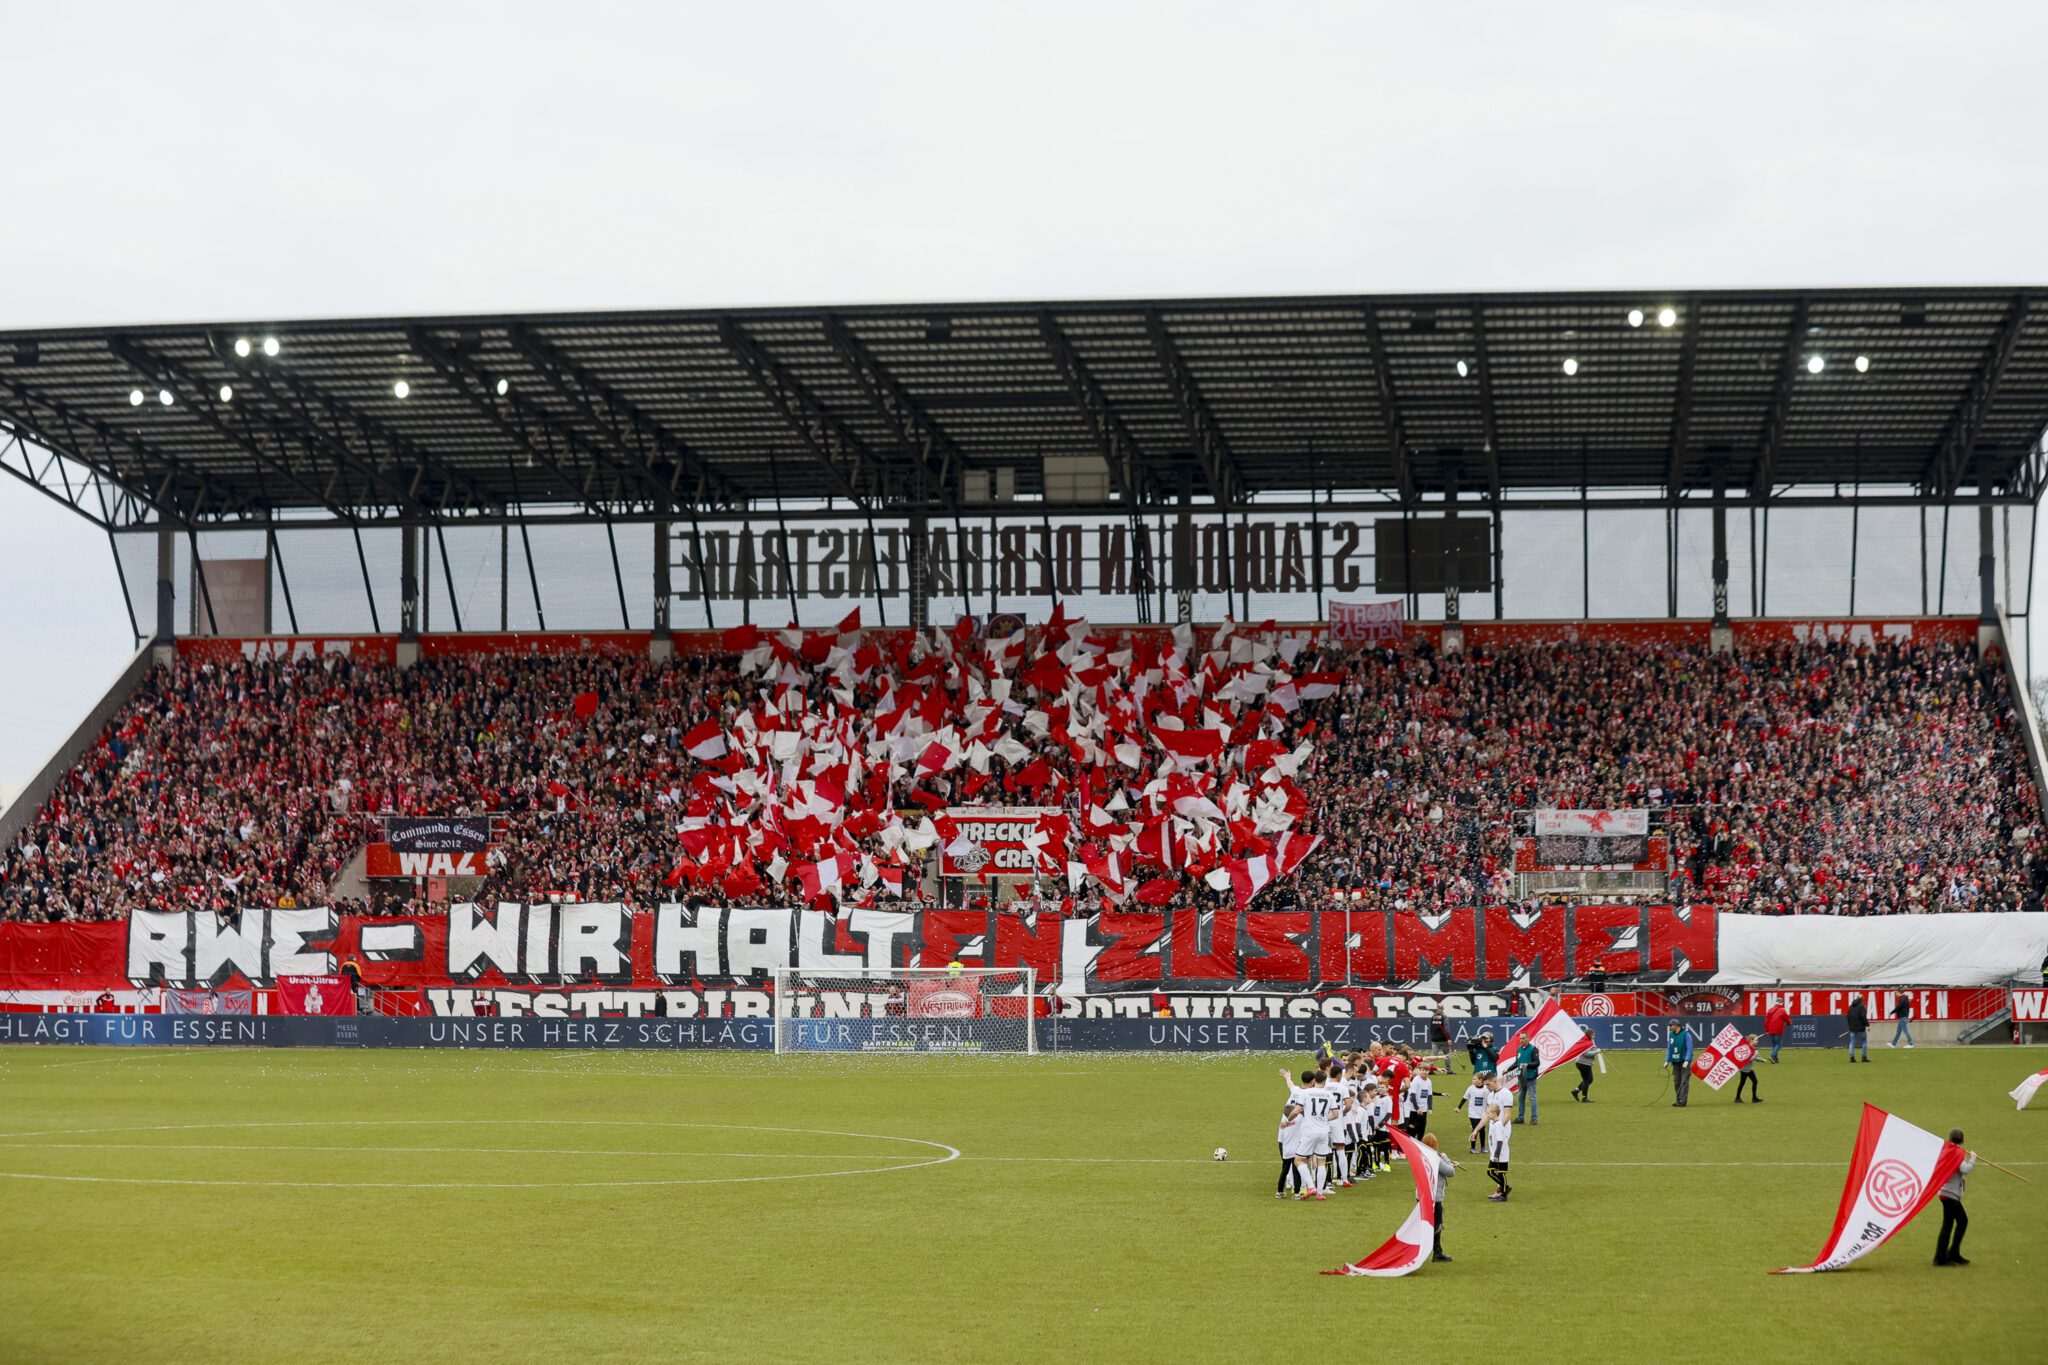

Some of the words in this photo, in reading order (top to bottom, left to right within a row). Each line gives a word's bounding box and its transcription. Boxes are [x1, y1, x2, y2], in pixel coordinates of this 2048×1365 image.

[391, 822, 450, 842] Commando
[453, 824, 486, 843] Essen
[415, 839, 439, 848] Since
[440, 840, 462, 848] 2012
[399, 852, 476, 875] WAZ
[994, 848, 1035, 868] CRE
[126, 905, 338, 986] RWE
[448, 902, 634, 983] WIR
[655, 903, 1064, 983] HALTEN
[1096, 904, 1718, 983] ZUSAMMEN
[106, 1016, 156, 1039] FÜR
[173, 1020, 267, 1041] ESSEN!
[429, 1022, 525, 1043] UNSER
[543, 1023, 620, 1043] HERZ
[638, 1020, 776, 1044] SCHLÄGT
[1149, 1024, 1250, 1044] UNSER
[1270, 1024, 1350, 1044] HERZ
[1370, 1020, 1516, 1044] SCHÄGT
[1612, 1023, 1716, 1044] ESSN!
[1792, 1031, 1817, 1039] ESSEN
[1310, 1097, 1329, 1117] 17
